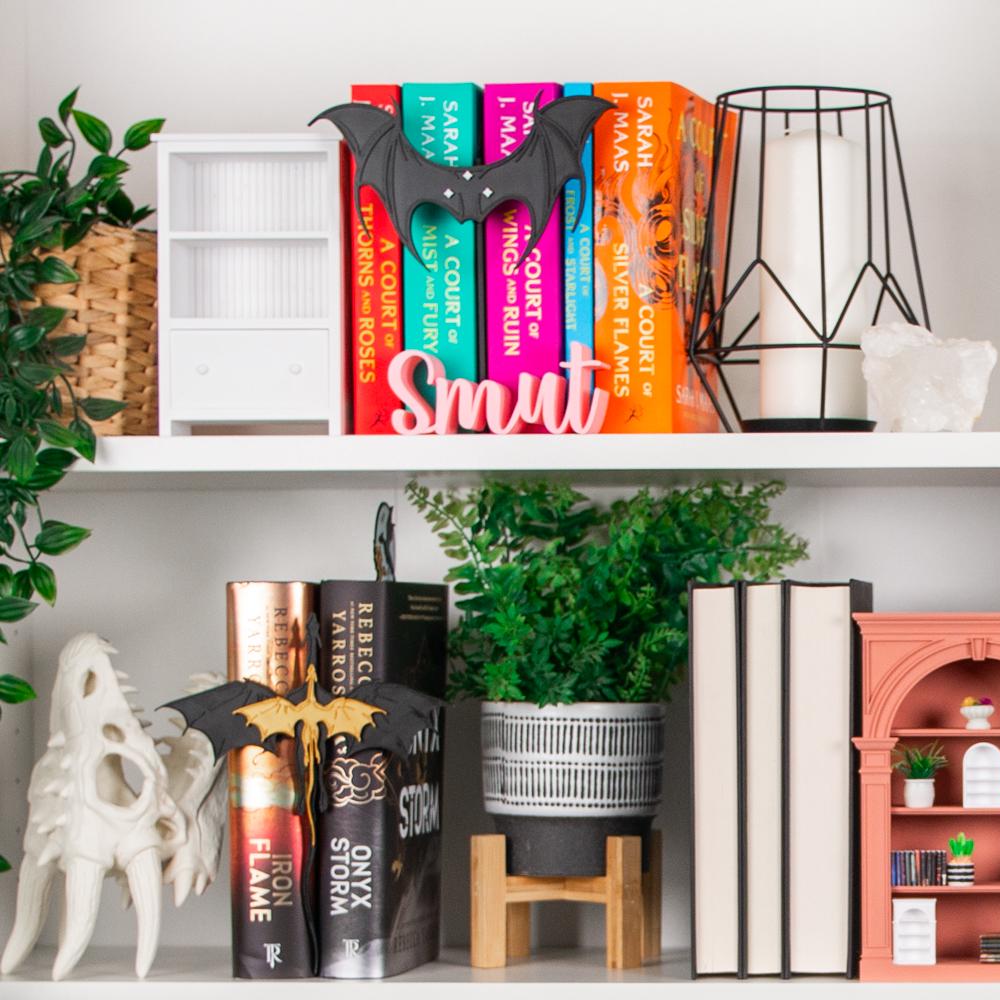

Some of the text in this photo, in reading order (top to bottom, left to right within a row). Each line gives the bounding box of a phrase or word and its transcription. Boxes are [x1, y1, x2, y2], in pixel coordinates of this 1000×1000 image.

[612, 92, 629, 173] J. MAAS
[637, 96, 653, 168] SARAH
[357, 203, 375, 384] THORNS AND ROSES
[381, 239, 397, 329] A COURT
[421, 225, 439, 355] MIST AND FURY
[445, 235, 460, 327] A COURT
[502, 210, 520, 357] WINGS AND RUIN
[525, 248, 542, 319] COURT
[566, 190, 577, 331] FROST STARLIGHT
[580, 224, 590, 284] A COURT
[612, 243, 630, 398] SILVER FLAMES
[638, 283, 655, 375] A COURT
[387, 342, 611, 436] Smut
[331, 610, 347, 696] YARROS
[400, 783, 439, 839] STORM
[249, 837, 272, 923] FLAME
[272, 853, 293, 907] IRON
[330, 837, 350, 917] STORM
[350, 844, 372, 909] ONYX
